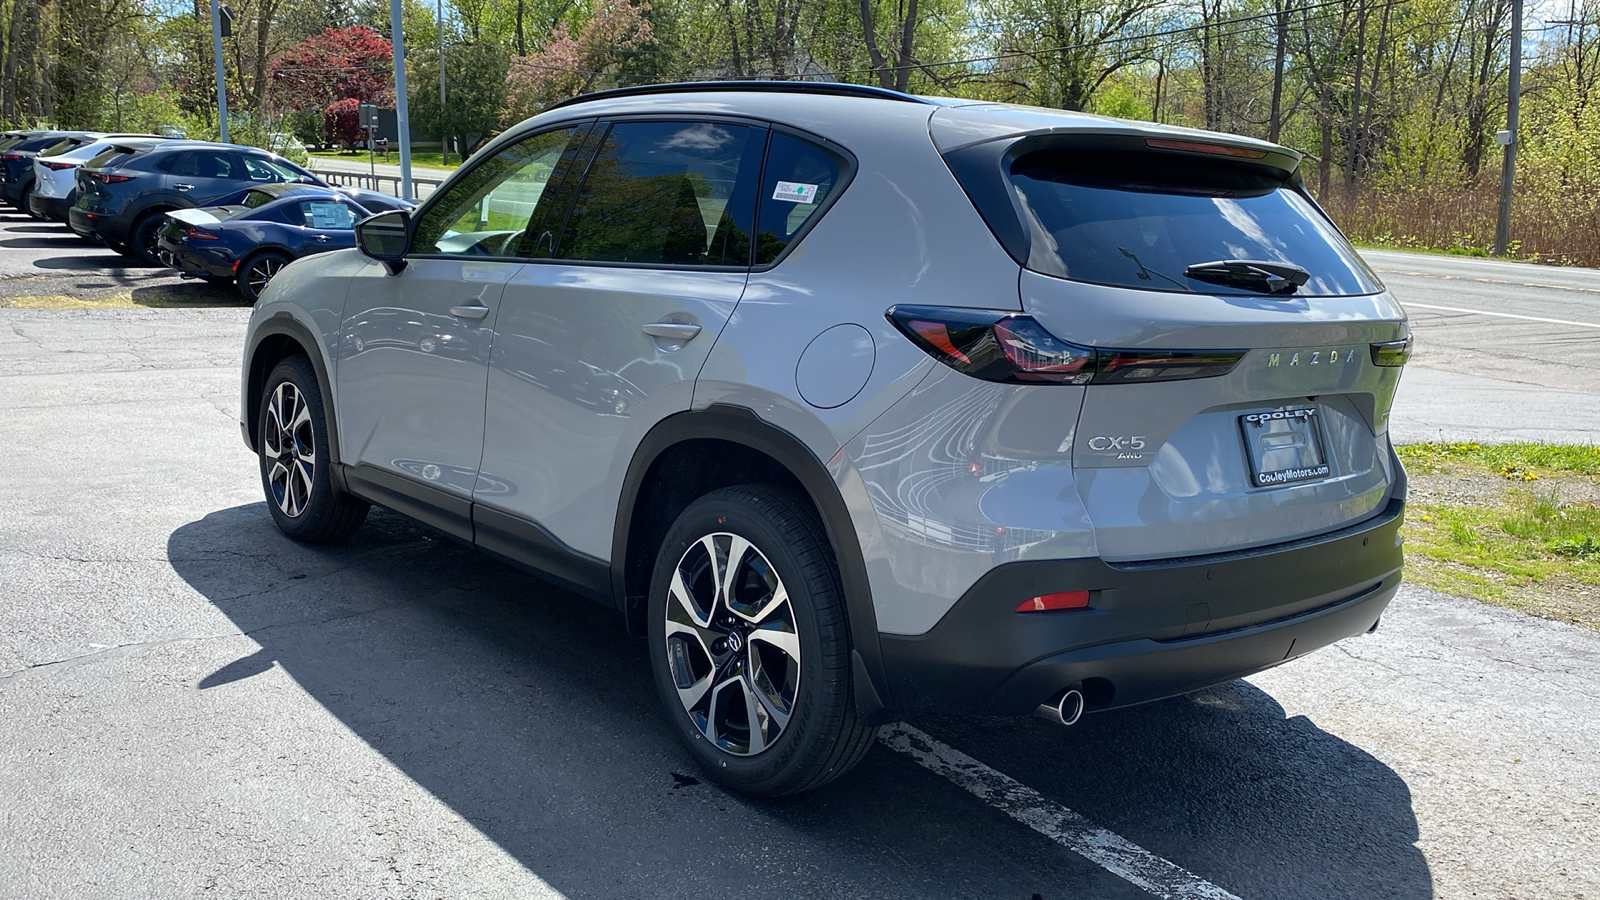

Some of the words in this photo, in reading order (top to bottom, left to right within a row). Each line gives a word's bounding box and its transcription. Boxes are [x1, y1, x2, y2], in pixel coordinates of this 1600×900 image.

[1267, 349, 1354, 367] MAZDA
[1246, 408, 1316, 422] COOLEY
[1088, 435, 1146, 451] CX-5
[1117, 452, 1142, 460] AWD
[1259, 466, 1329, 483] CooleyMotors.com
